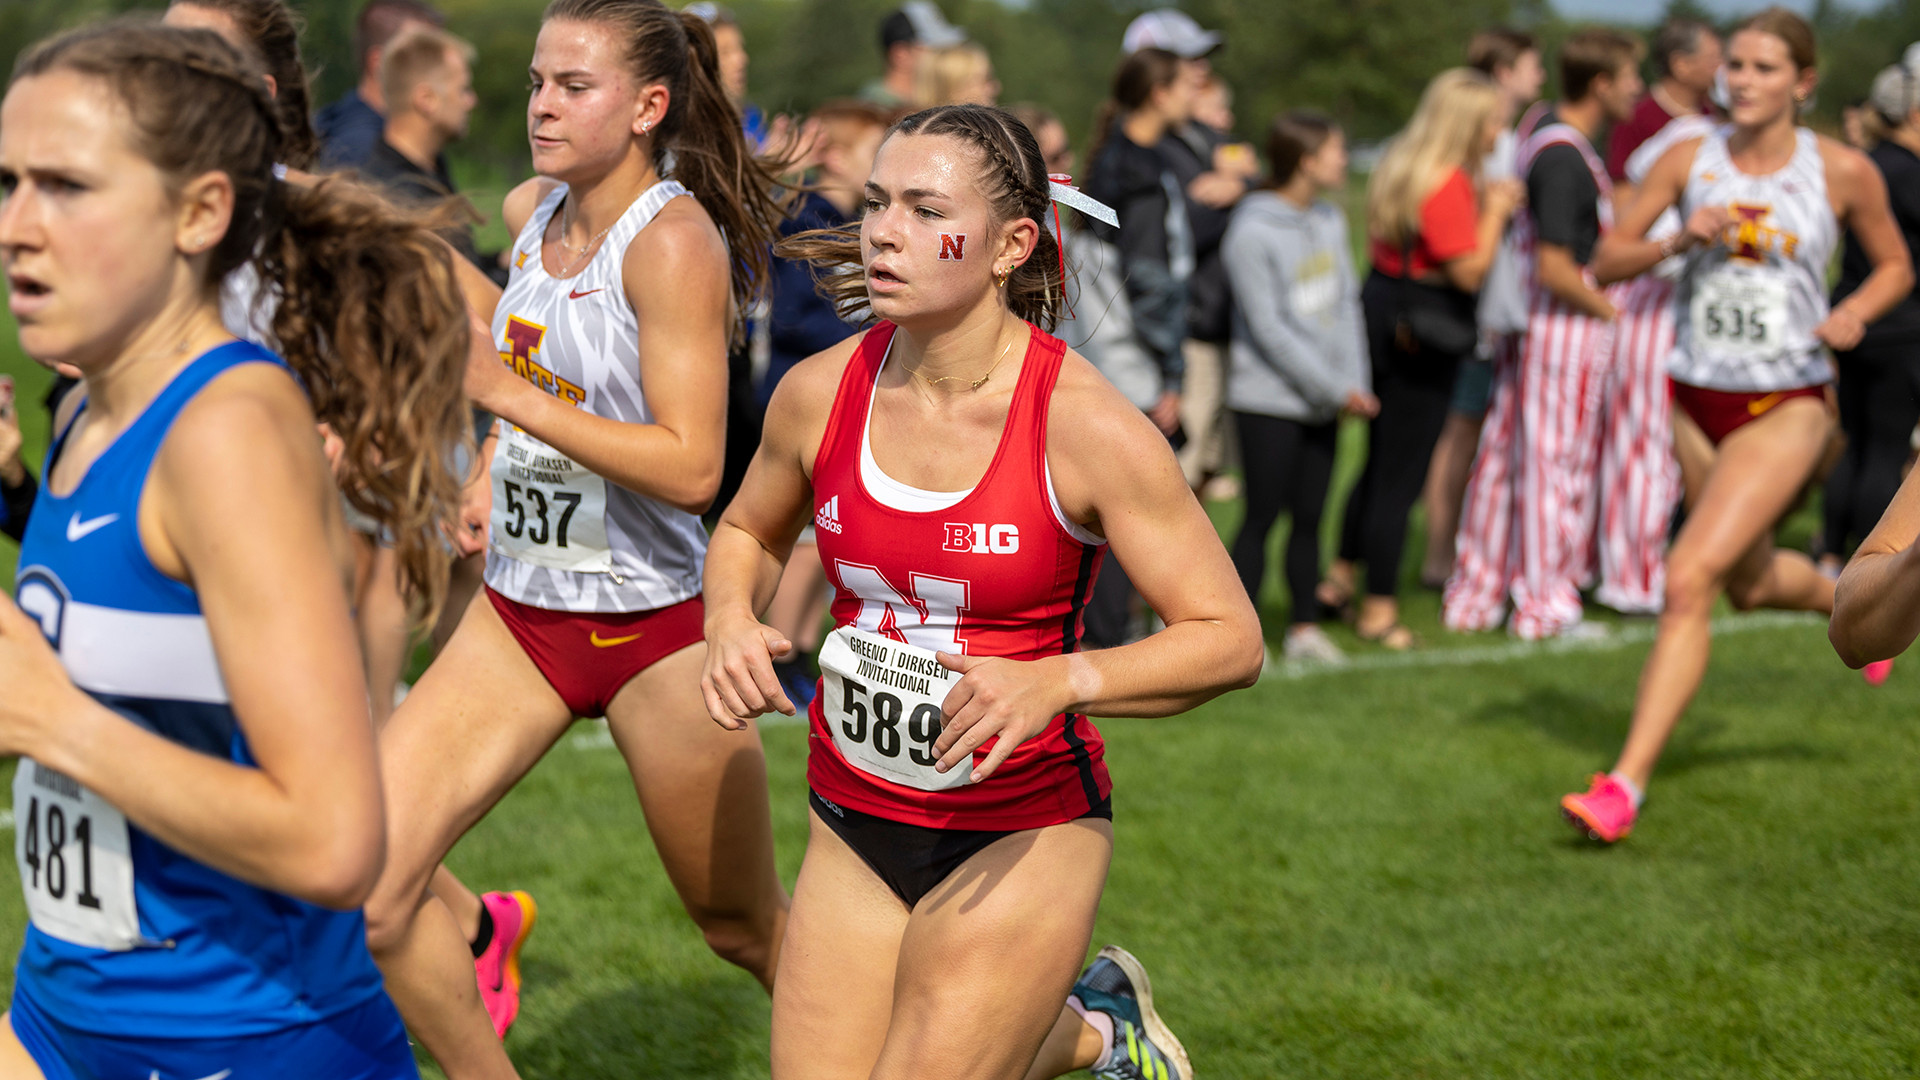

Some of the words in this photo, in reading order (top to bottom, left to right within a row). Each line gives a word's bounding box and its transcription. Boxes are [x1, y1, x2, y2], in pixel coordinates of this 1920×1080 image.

[937, 232, 967, 262] N
[504, 479, 582, 548] 537
[815, 513, 843, 535] adidas
[834, 558, 970, 655] N
[850, 636, 888, 663] GREENO
[897, 652, 950, 681] DIRKSEN
[856, 658, 931, 697] INVITATIONAL
[840, 676, 943, 767] 589
[26, 795, 101, 911] 481
